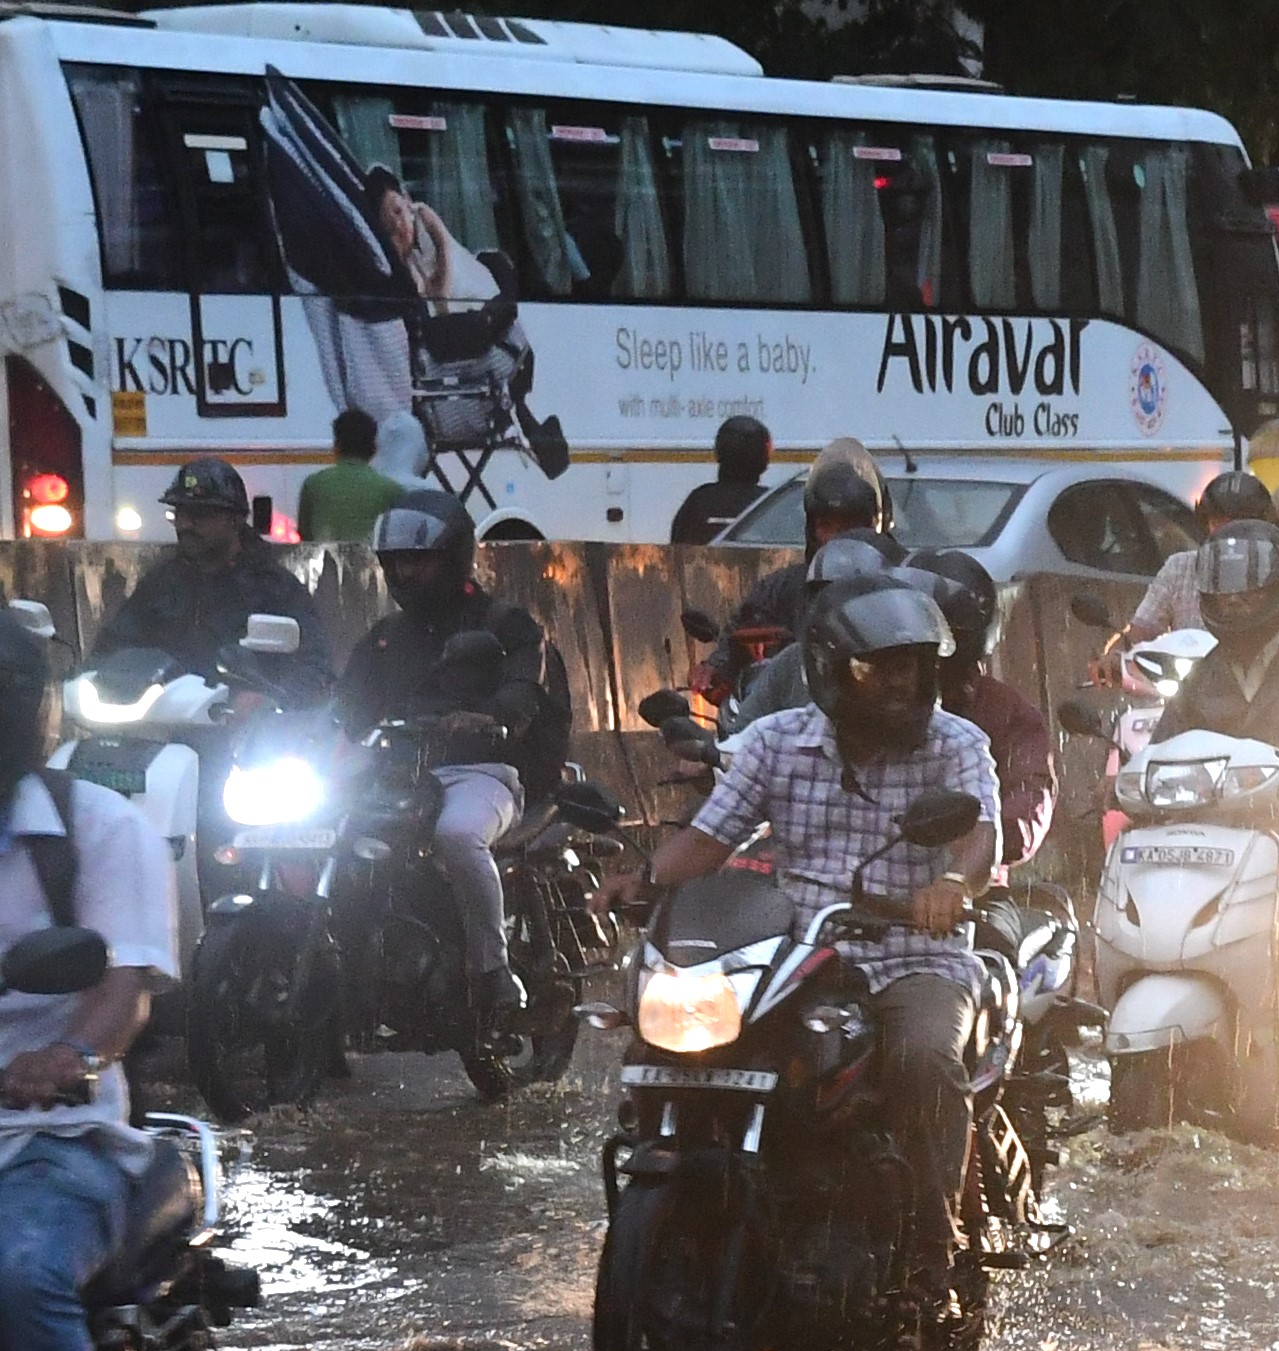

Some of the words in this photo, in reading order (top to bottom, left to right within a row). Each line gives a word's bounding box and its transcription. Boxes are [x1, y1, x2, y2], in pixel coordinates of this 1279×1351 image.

[114, 336, 254, 396] KSRTC
[616, 327, 683, 382] Sleep
[690, 332, 729, 372] like
[737, 342, 751, 373] a
[758, 333, 817, 385] baby.
[985, 402, 1025, 437] Club
[1033, 402, 1079, 438] Class
